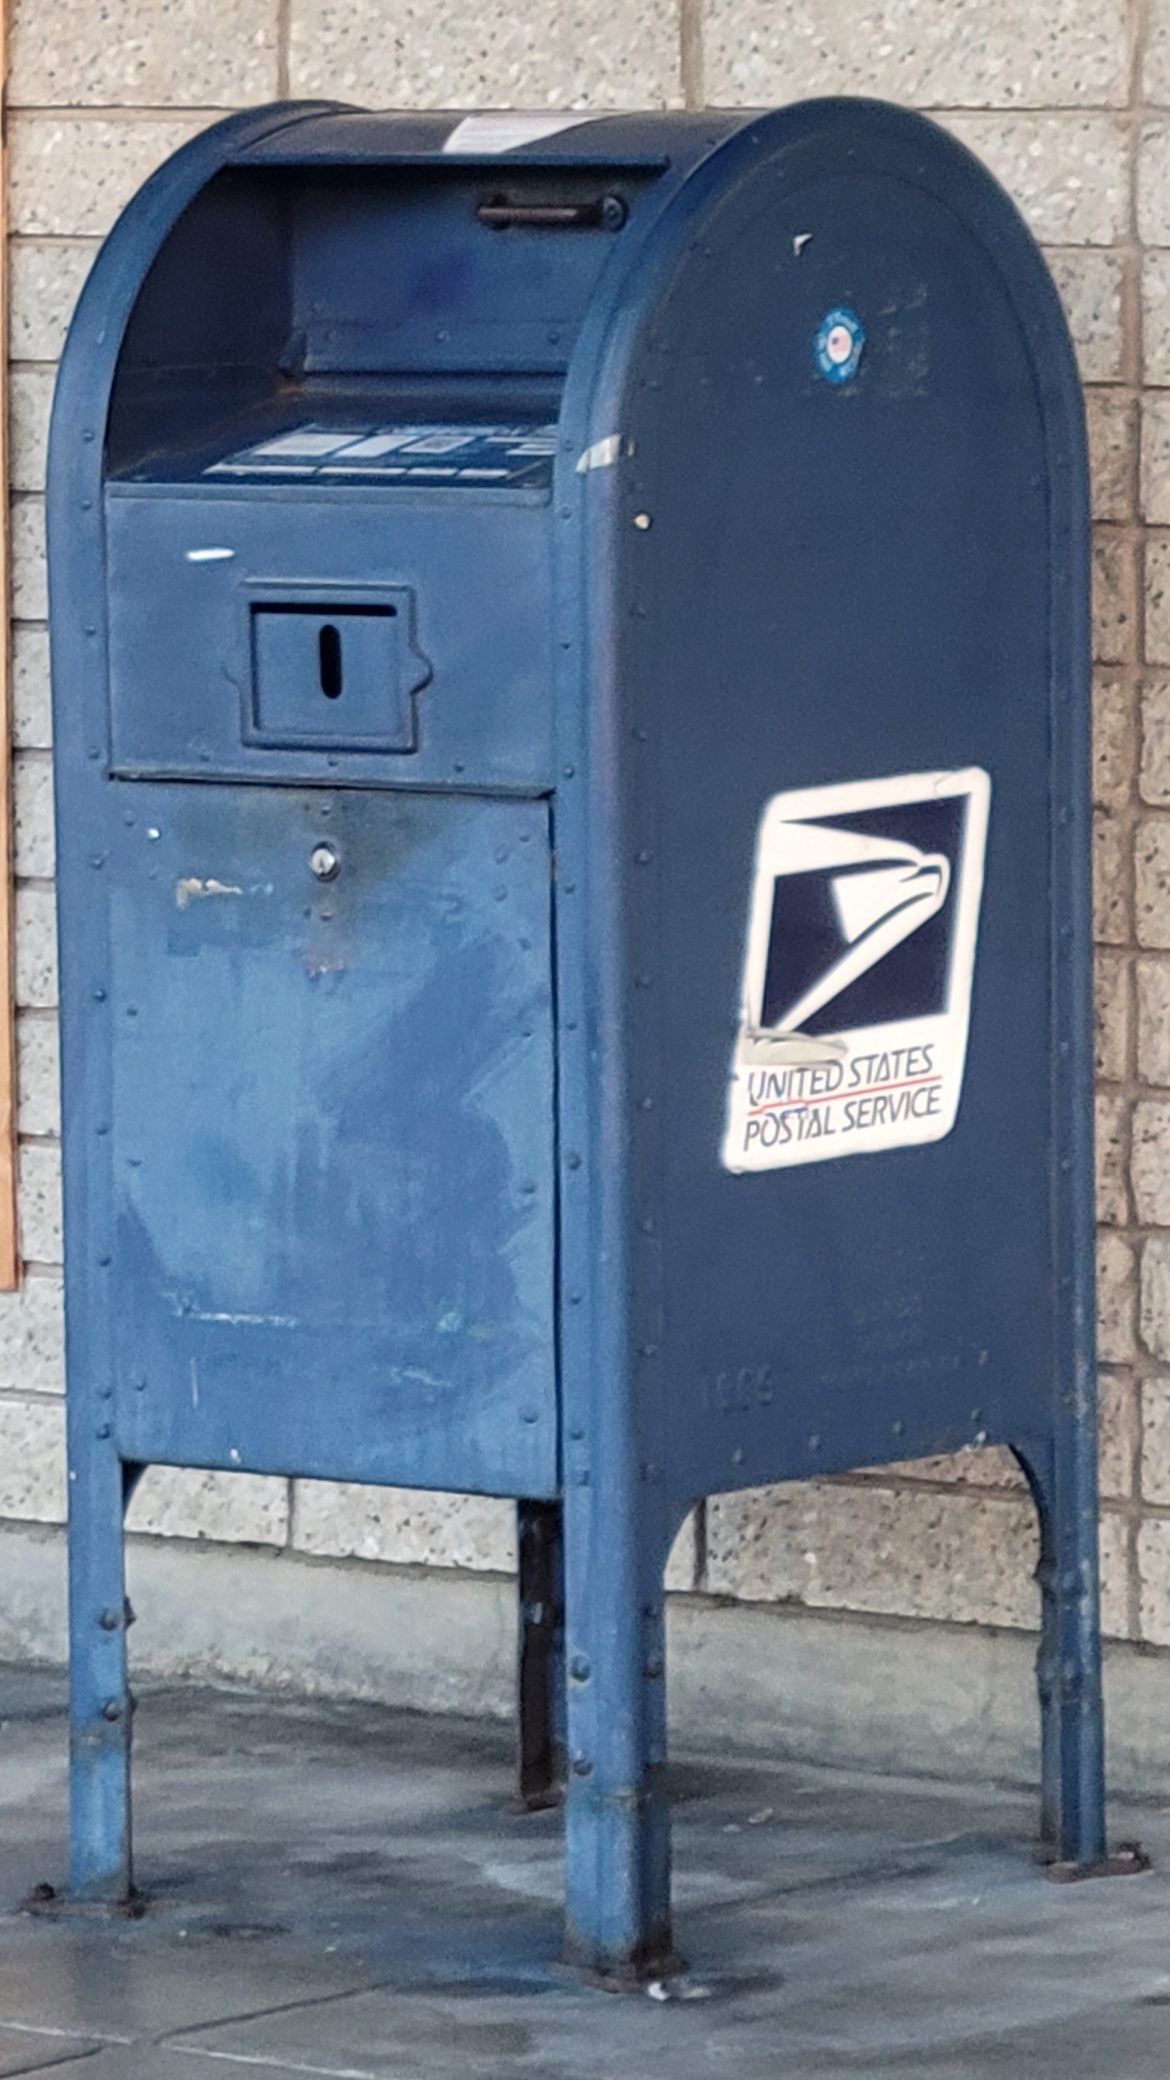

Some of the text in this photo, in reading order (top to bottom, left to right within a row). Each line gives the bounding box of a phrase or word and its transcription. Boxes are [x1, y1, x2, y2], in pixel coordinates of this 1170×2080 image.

[748, 1044, 935, 1106] UNITED STATES
[744, 1085, 943, 1152] POSTAL SERVICE
